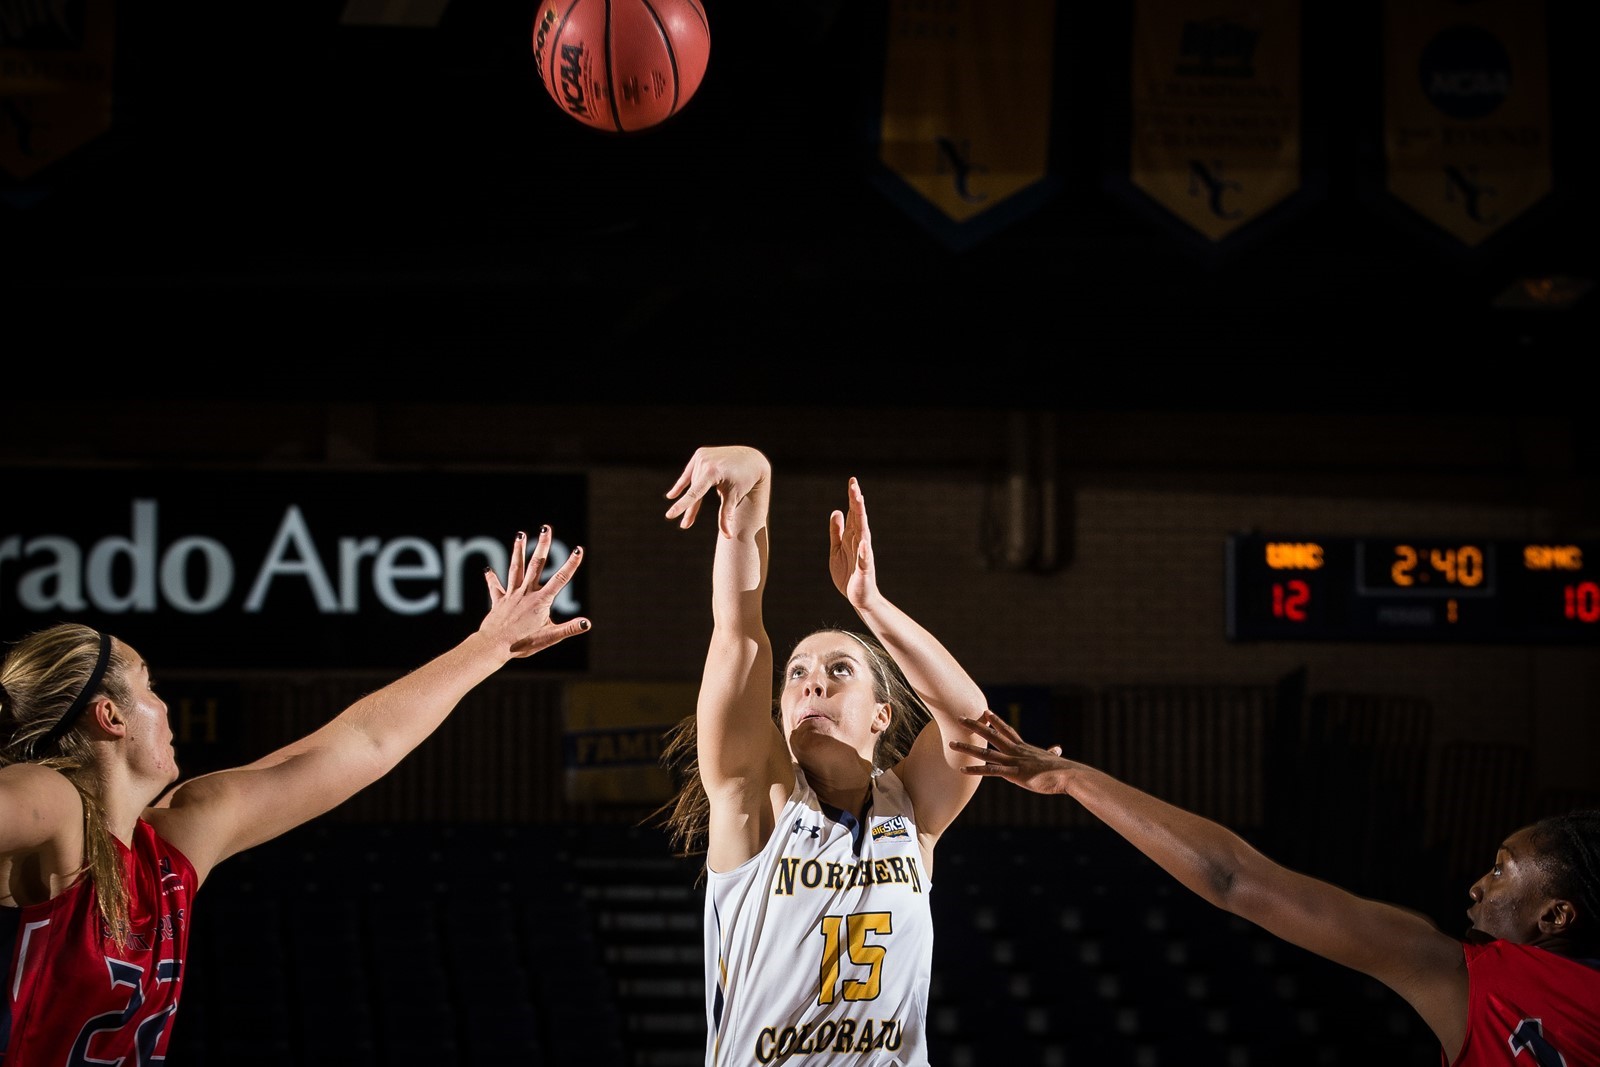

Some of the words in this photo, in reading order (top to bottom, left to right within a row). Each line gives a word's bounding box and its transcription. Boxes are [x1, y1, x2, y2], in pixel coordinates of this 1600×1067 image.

[561, 41, 592, 119] NCAA
[1391, 544, 1484, 587] 2:40
[1272, 579, 1312, 622] 12
[1445, 598, 1460, 625] 1
[1564, 581, 1600, 622] 10
[775, 856, 922, 895] NORTHERN
[817, 912, 893, 1006] 15
